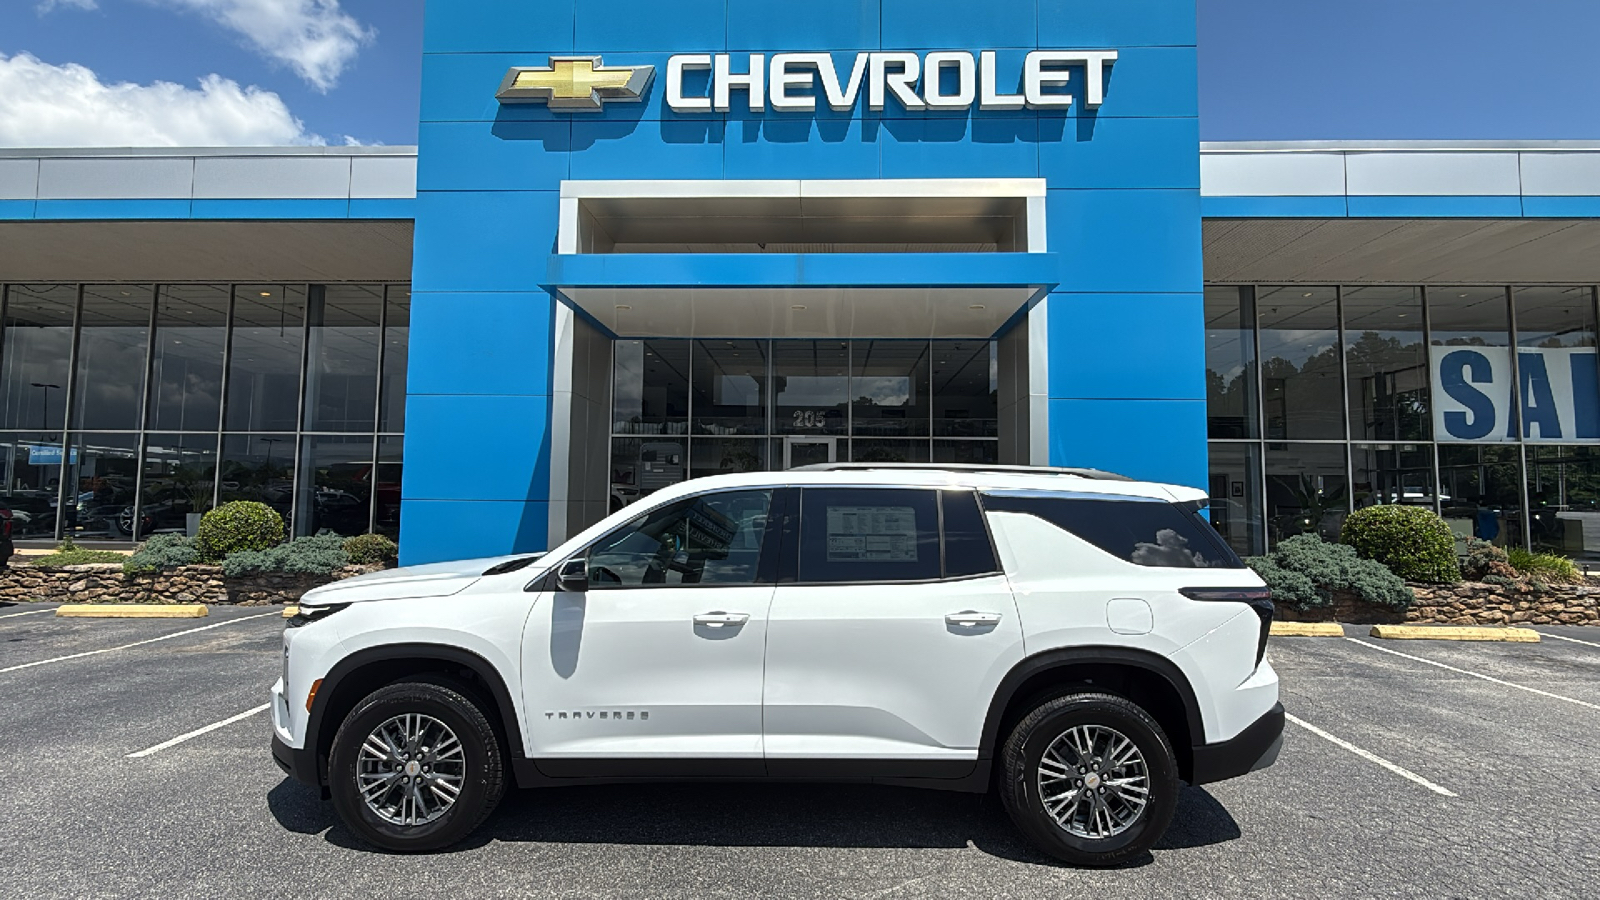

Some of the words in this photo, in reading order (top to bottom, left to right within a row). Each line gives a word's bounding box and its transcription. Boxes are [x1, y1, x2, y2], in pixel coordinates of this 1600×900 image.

[665, 49, 1119, 113] CHEVROLET
[793, 410, 826, 427] 205
[544, 711, 649, 720] TRAVERSE
